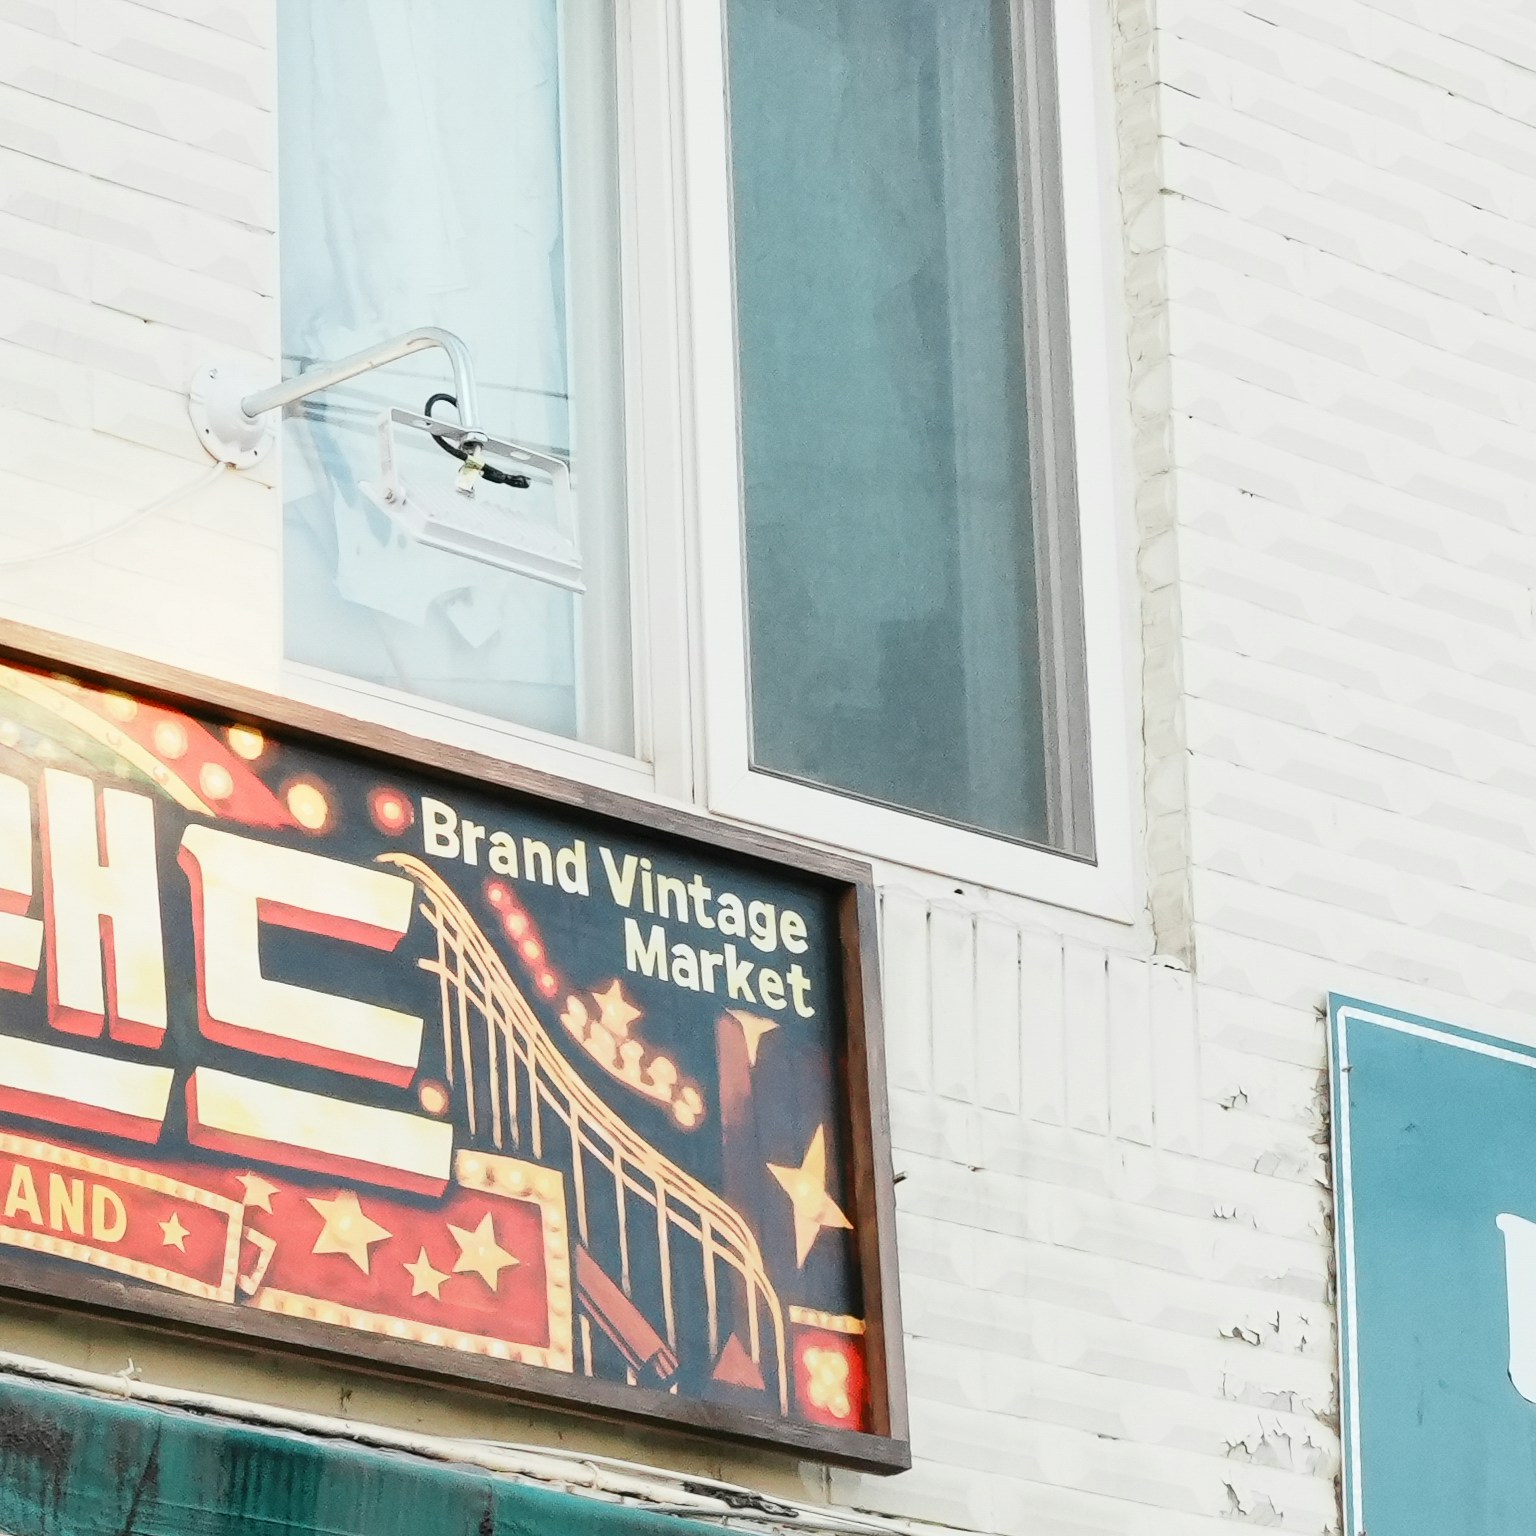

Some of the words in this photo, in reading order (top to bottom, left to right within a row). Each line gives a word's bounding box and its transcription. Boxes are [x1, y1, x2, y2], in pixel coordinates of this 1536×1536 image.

[421, 797, 590, 897] Brand
[599, 846, 809, 954] Vintage
[624, 918, 815, 1019] Market
